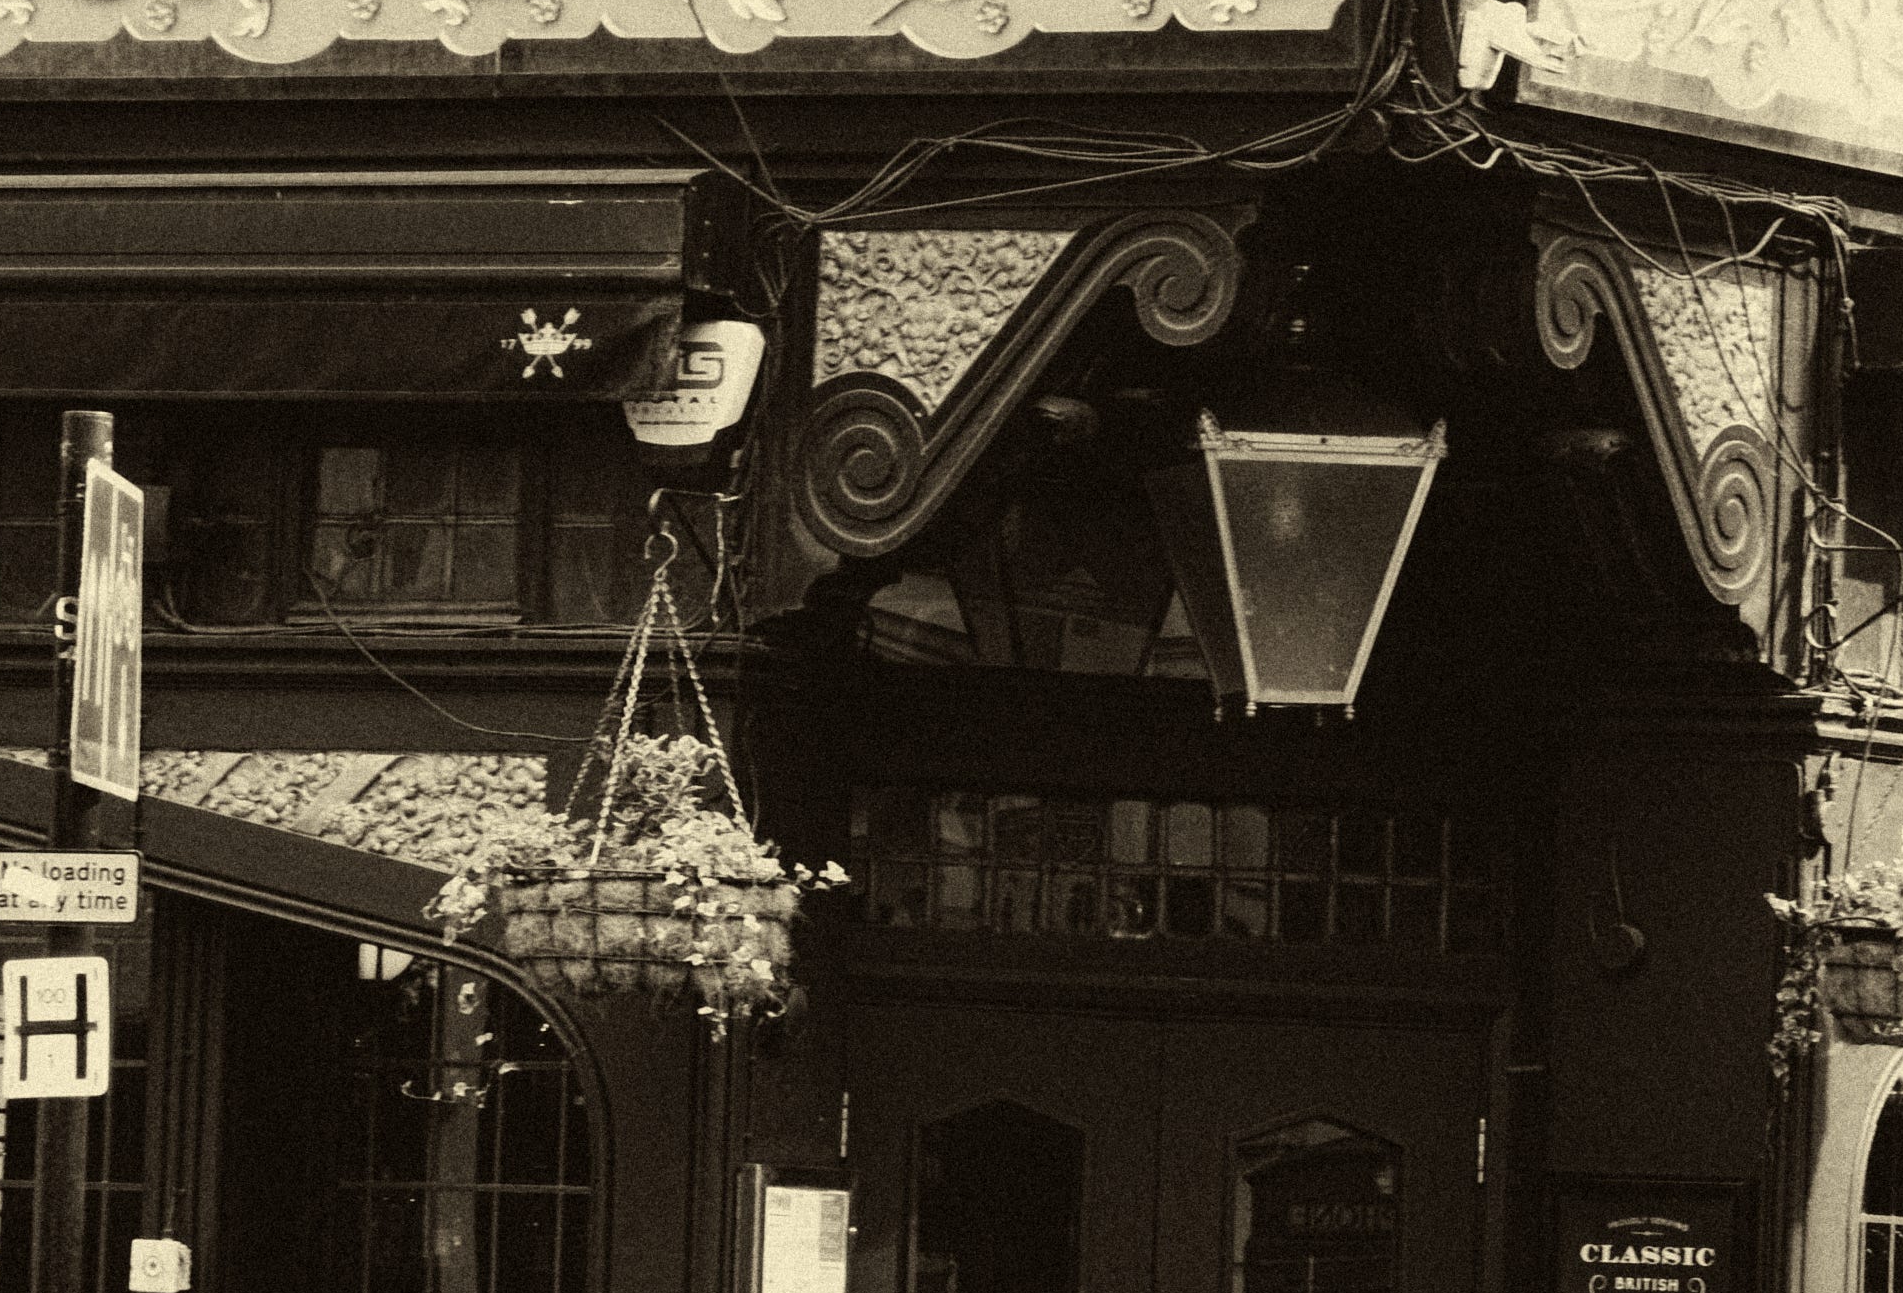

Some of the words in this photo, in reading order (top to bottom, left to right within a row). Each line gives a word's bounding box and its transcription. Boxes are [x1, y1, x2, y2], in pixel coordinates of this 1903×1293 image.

[41, 860, 126, 886] loading
[28, 894, 68, 913] ay
[77, 890, 128, 910] time
[1580, 1243, 1716, 1267] CLASSIC
[1614, 1276, 1680, 1292] BRITISH
